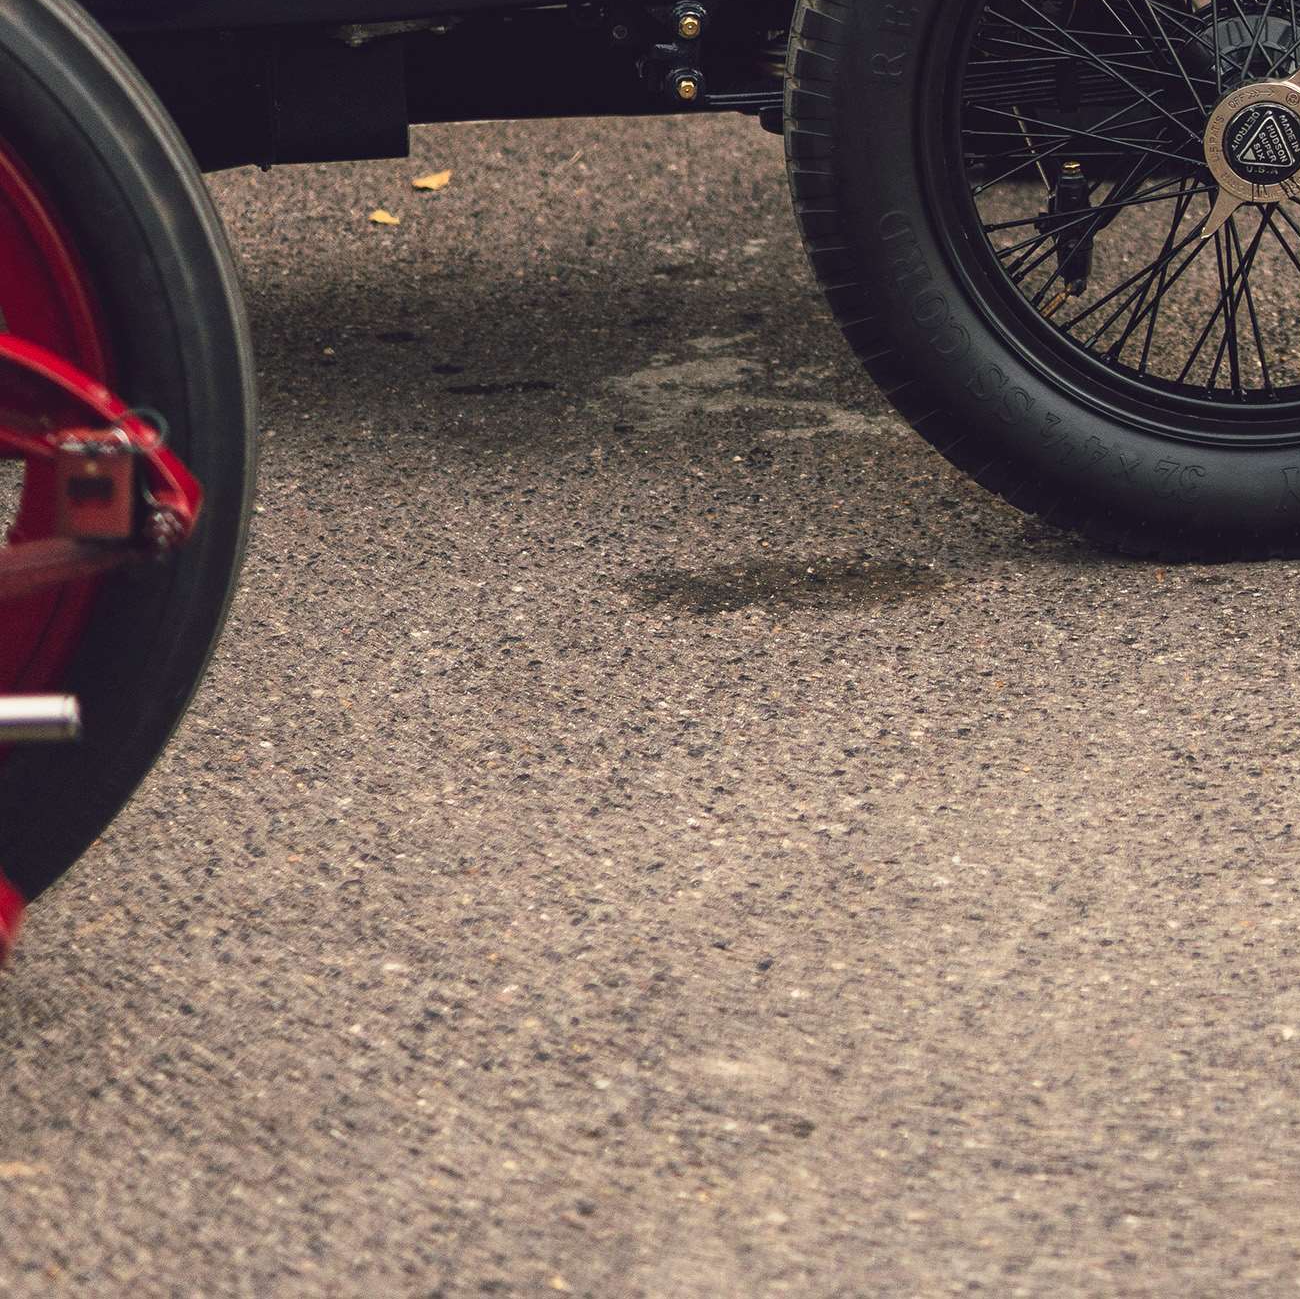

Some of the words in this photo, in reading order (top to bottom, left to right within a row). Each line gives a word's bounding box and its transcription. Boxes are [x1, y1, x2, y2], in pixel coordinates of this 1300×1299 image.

[1231, 110, 1260, 151] DETROIT
[1266, 124, 1288, 163] HUDSON
[1278, 114, 1297, 141] MADE
[1253, 143, 1266, 161] SIX
[1258, 132, 1277, 163] SUPER
[878, 209, 970, 365] CORD
